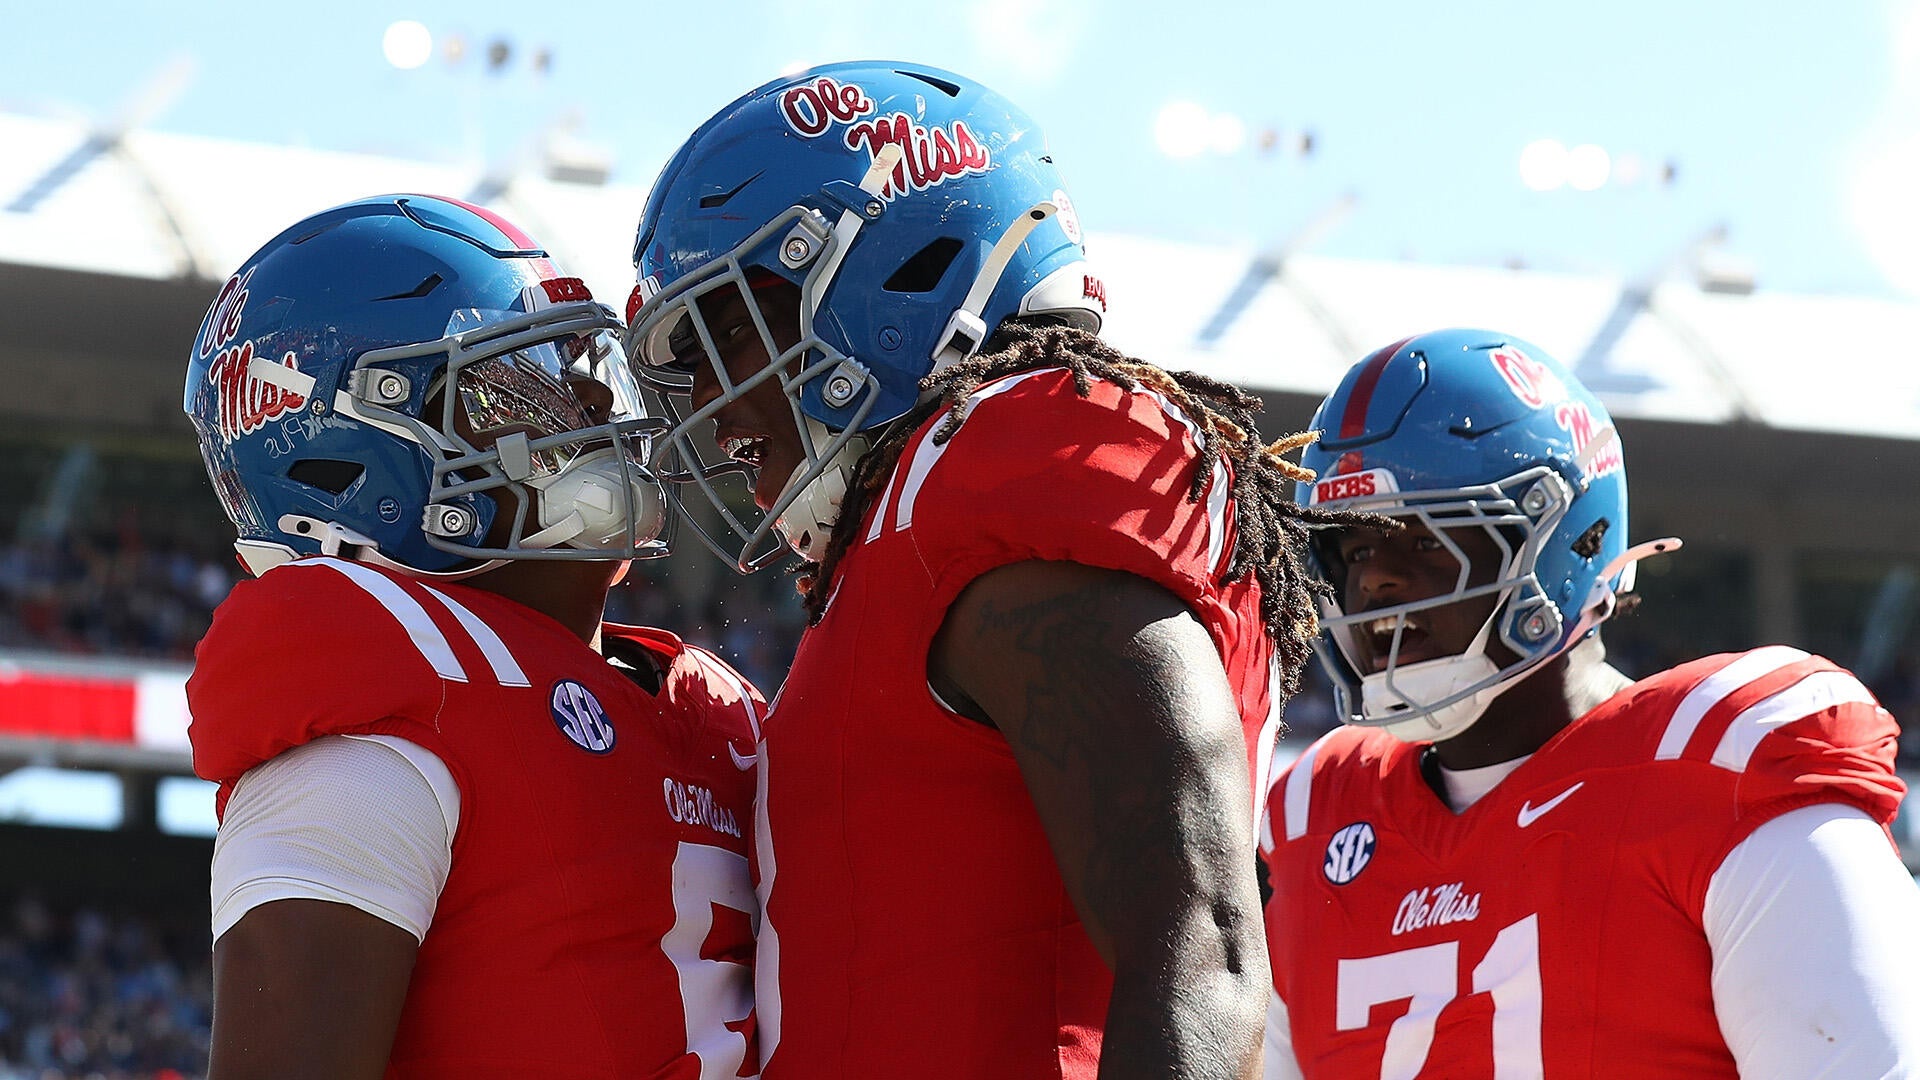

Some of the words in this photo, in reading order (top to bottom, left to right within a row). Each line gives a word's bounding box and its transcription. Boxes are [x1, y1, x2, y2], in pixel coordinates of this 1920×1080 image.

[779, 76, 876, 138] Ole
[843, 112, 991, 202] Miss
[1317, 472, 1376, 503] REBS
[552, 681, 615, 752] SEC
[663, 777, 700, 825] Ole
[687, 784, 741, 838] Miss
[1323, 822, 1377, 885] SEC
[1391, 887, 1430, 936] Ole
[1431, 881, 1481, 926] Miss
[1335, 912, 1544, 1080] 71
